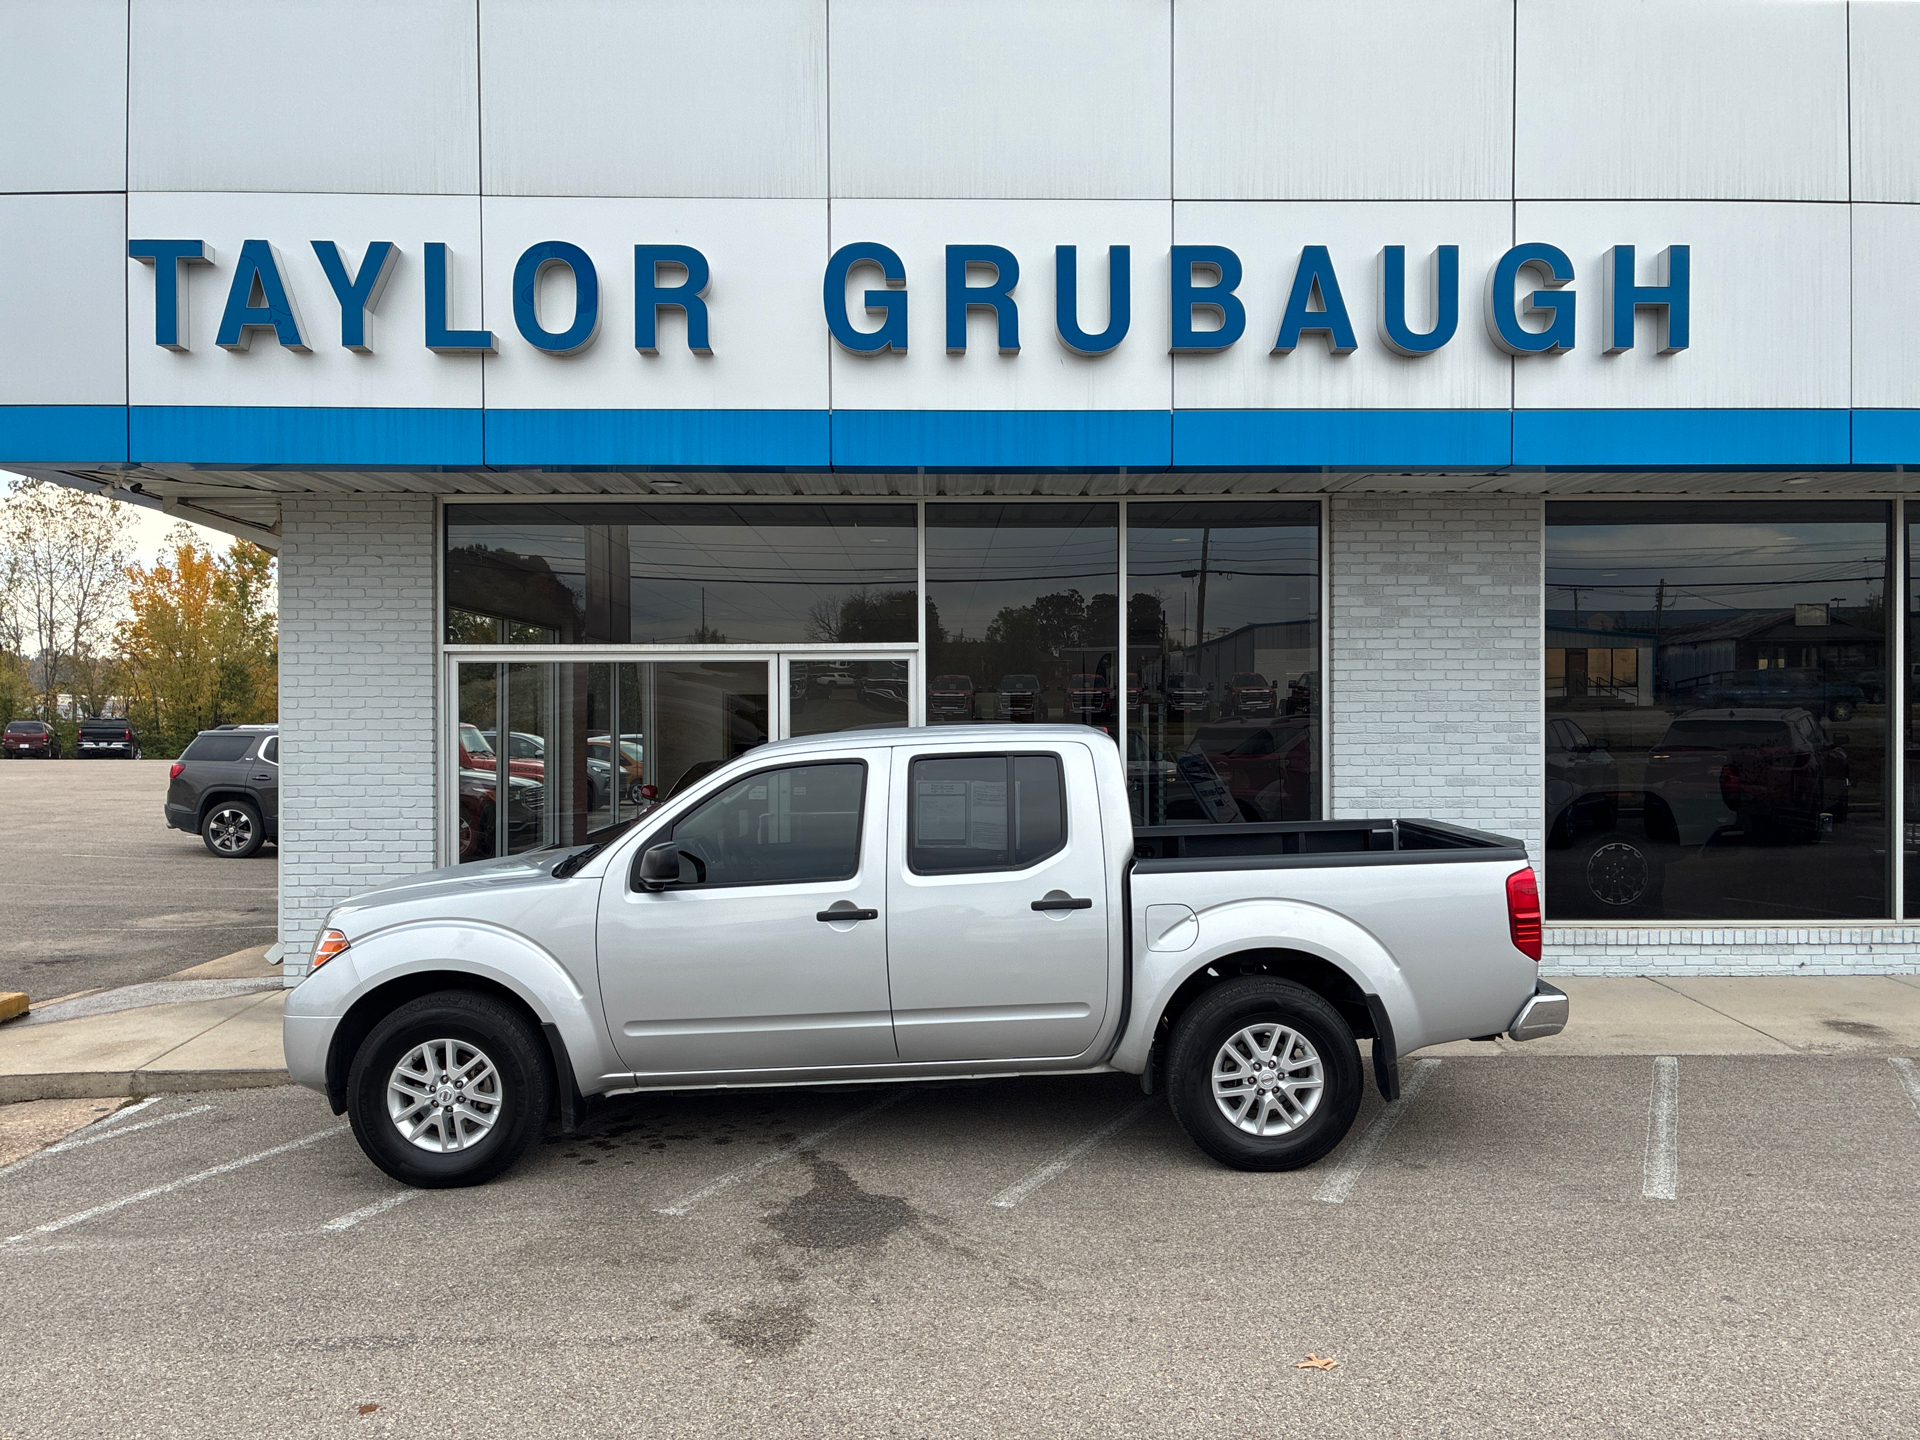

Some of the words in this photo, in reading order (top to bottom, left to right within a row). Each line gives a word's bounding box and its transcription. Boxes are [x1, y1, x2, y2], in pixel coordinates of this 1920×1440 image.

[128, 239, 713, 355] TAYLOR
[823, 242, 1691, 357] GRUBAUGH
[488, 764, 541, 772] RBICON
